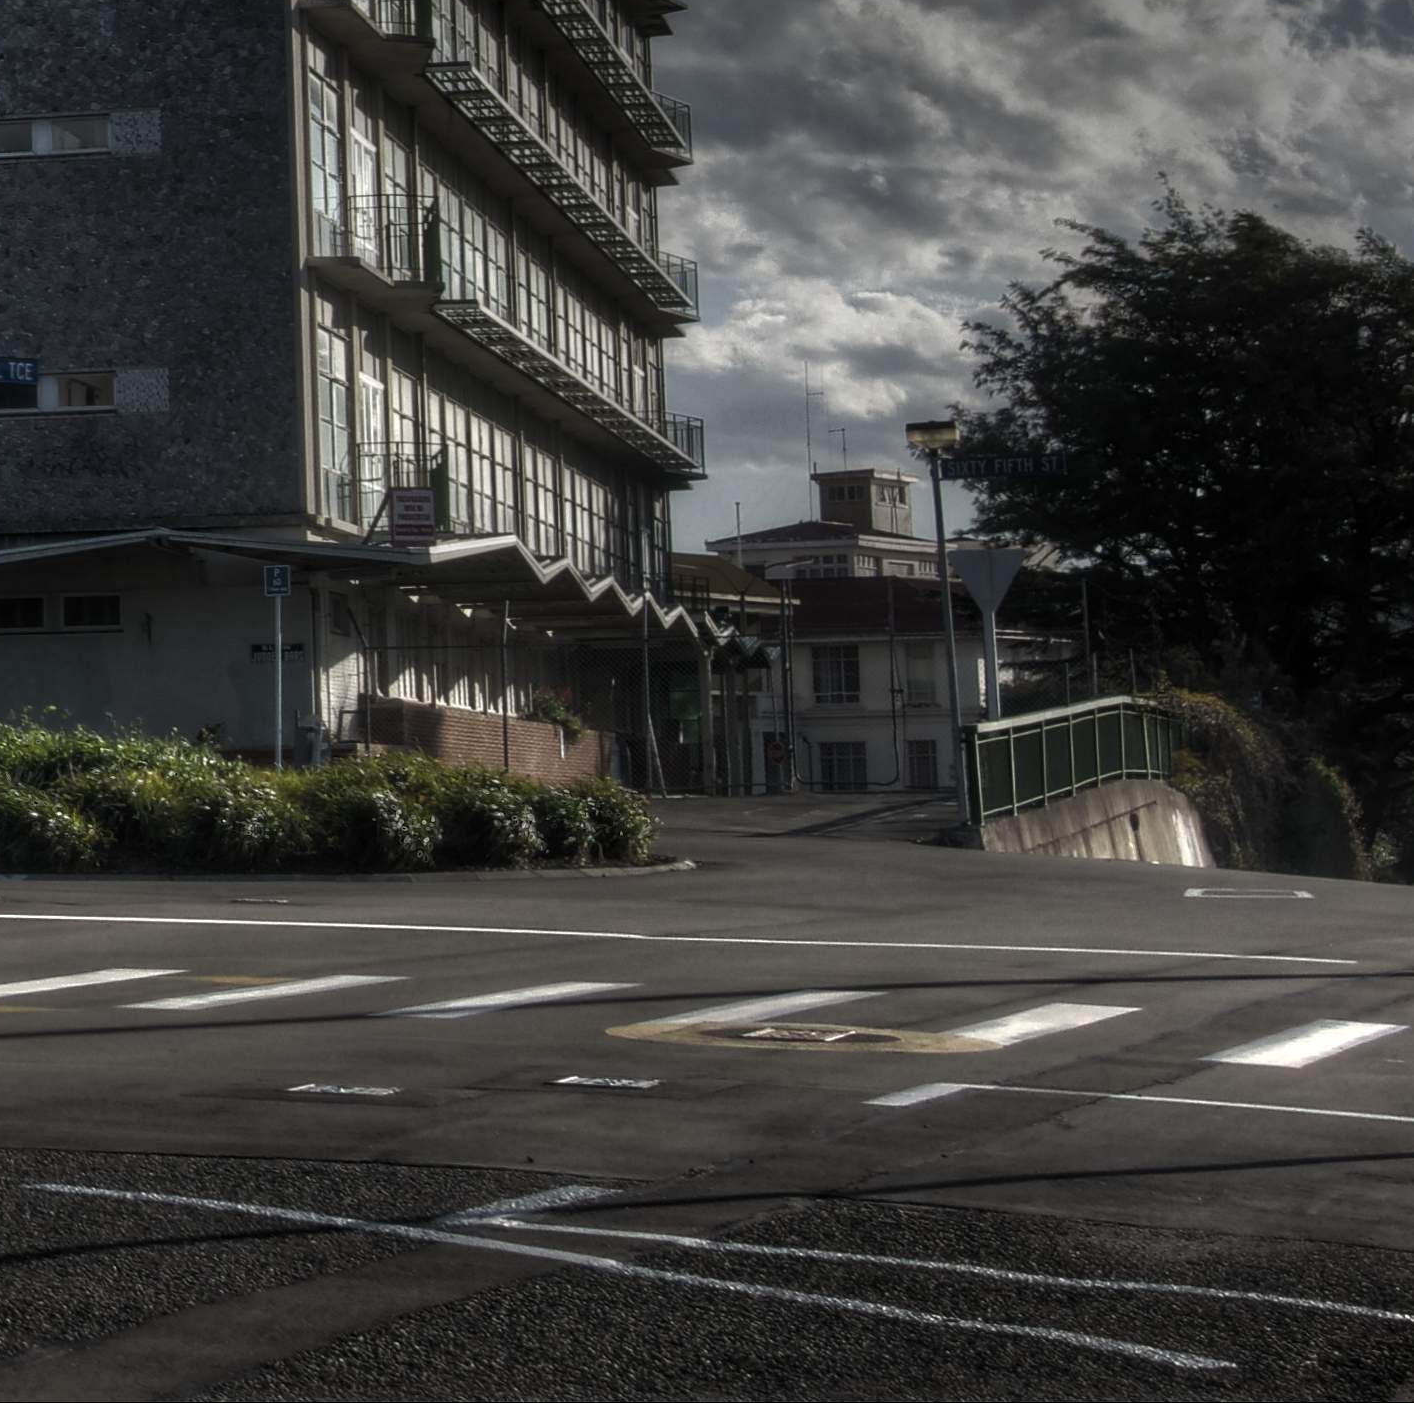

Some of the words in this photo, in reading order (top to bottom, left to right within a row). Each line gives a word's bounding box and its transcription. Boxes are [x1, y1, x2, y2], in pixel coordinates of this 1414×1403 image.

[9, 361, 34, 381] TCE
[947, 460, 986, 476] SIXTY
[994, 456, 1033, 473] FIFTH
[1041, 454, 1058, 471] ST
